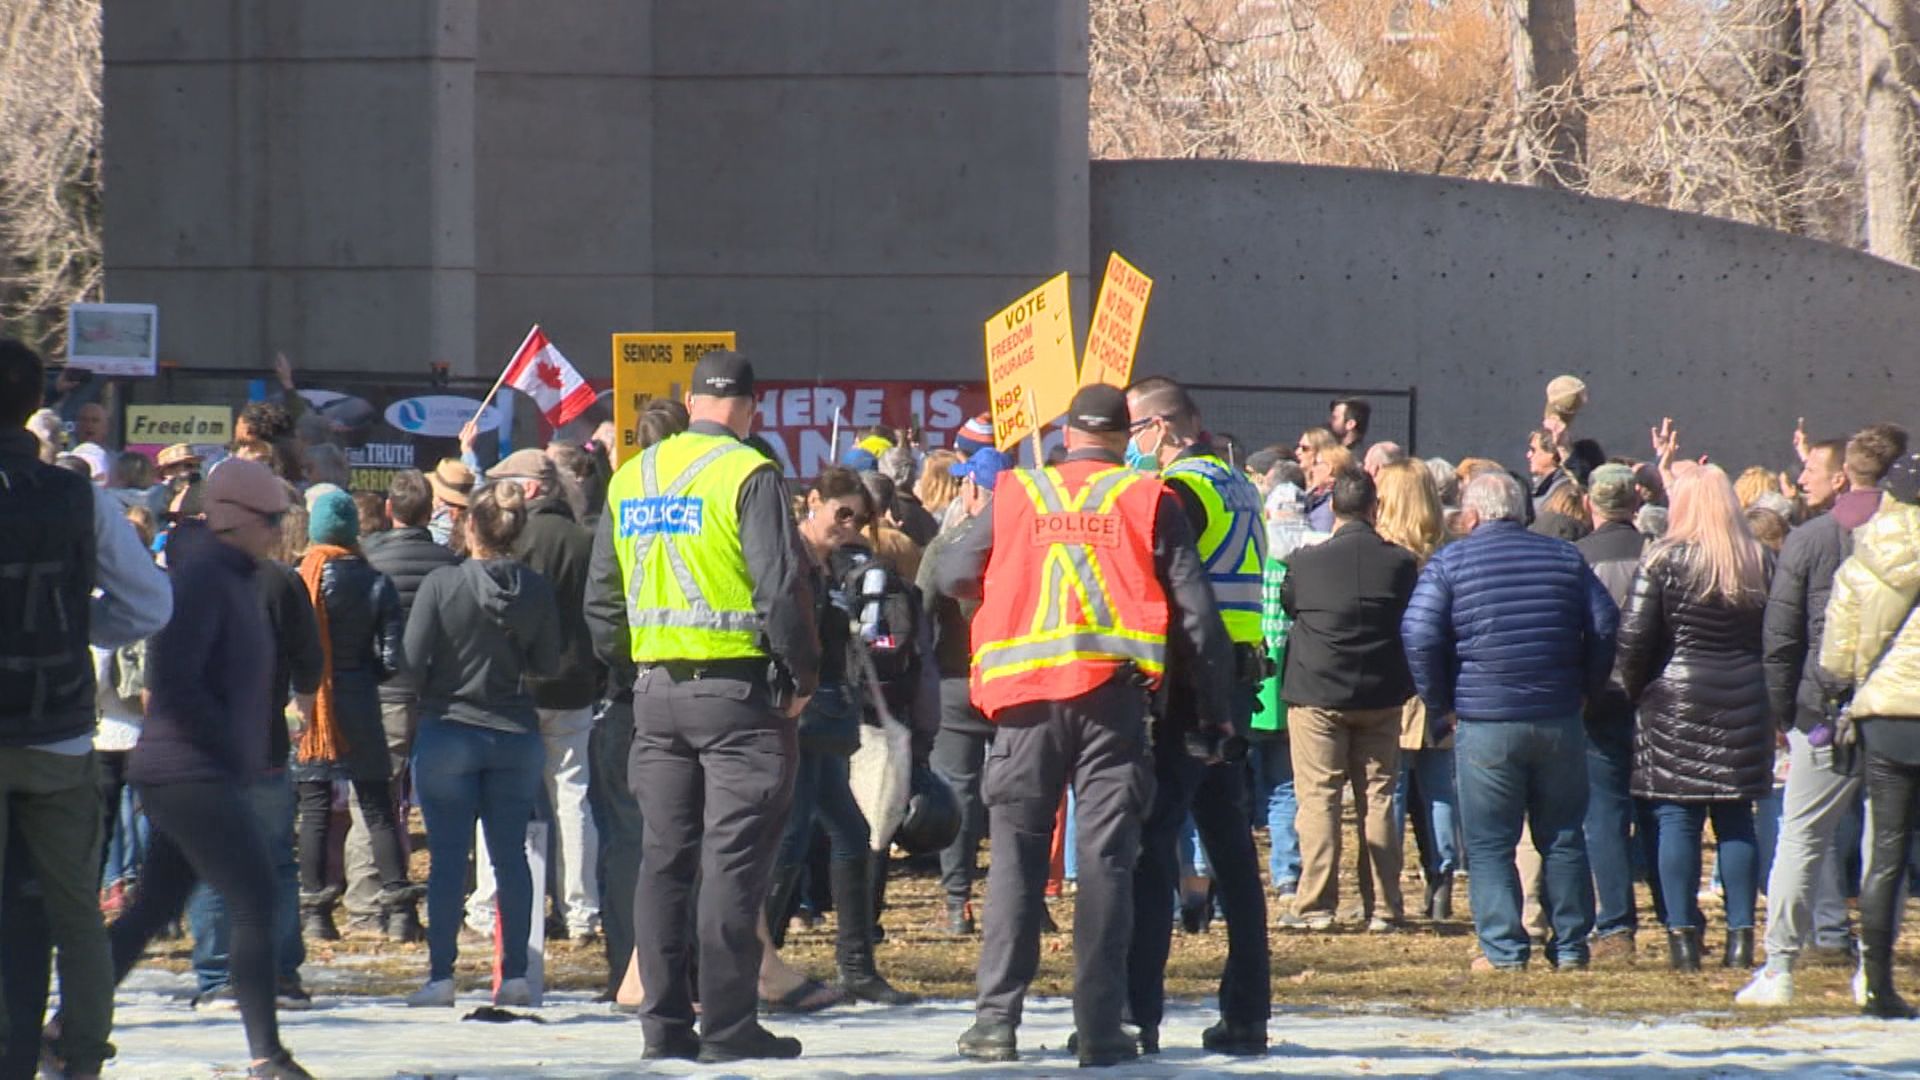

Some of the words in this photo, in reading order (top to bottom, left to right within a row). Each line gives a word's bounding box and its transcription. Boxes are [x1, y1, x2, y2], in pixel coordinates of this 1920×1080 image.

[1005, 291, 1047, 330] VOTE
[624, 343, 673, 363] SENIORS
[992, 323, 1033, 363] FREEDOM
[1099, 340, 1129, 377] CHOICE
[993, 345, 1035, 384] COURAGE
[754, 387, 885, 427] HERE
[910, 388, 963, 428] IS
[995, 384, 1022, 415] NDP
[131, 415, 225, 435] Freedom
[365, 443, 415, 464] TRUTH
[623, 503, 700, 529] POLICE
[1035, 516, 1114, 535] POLICE
